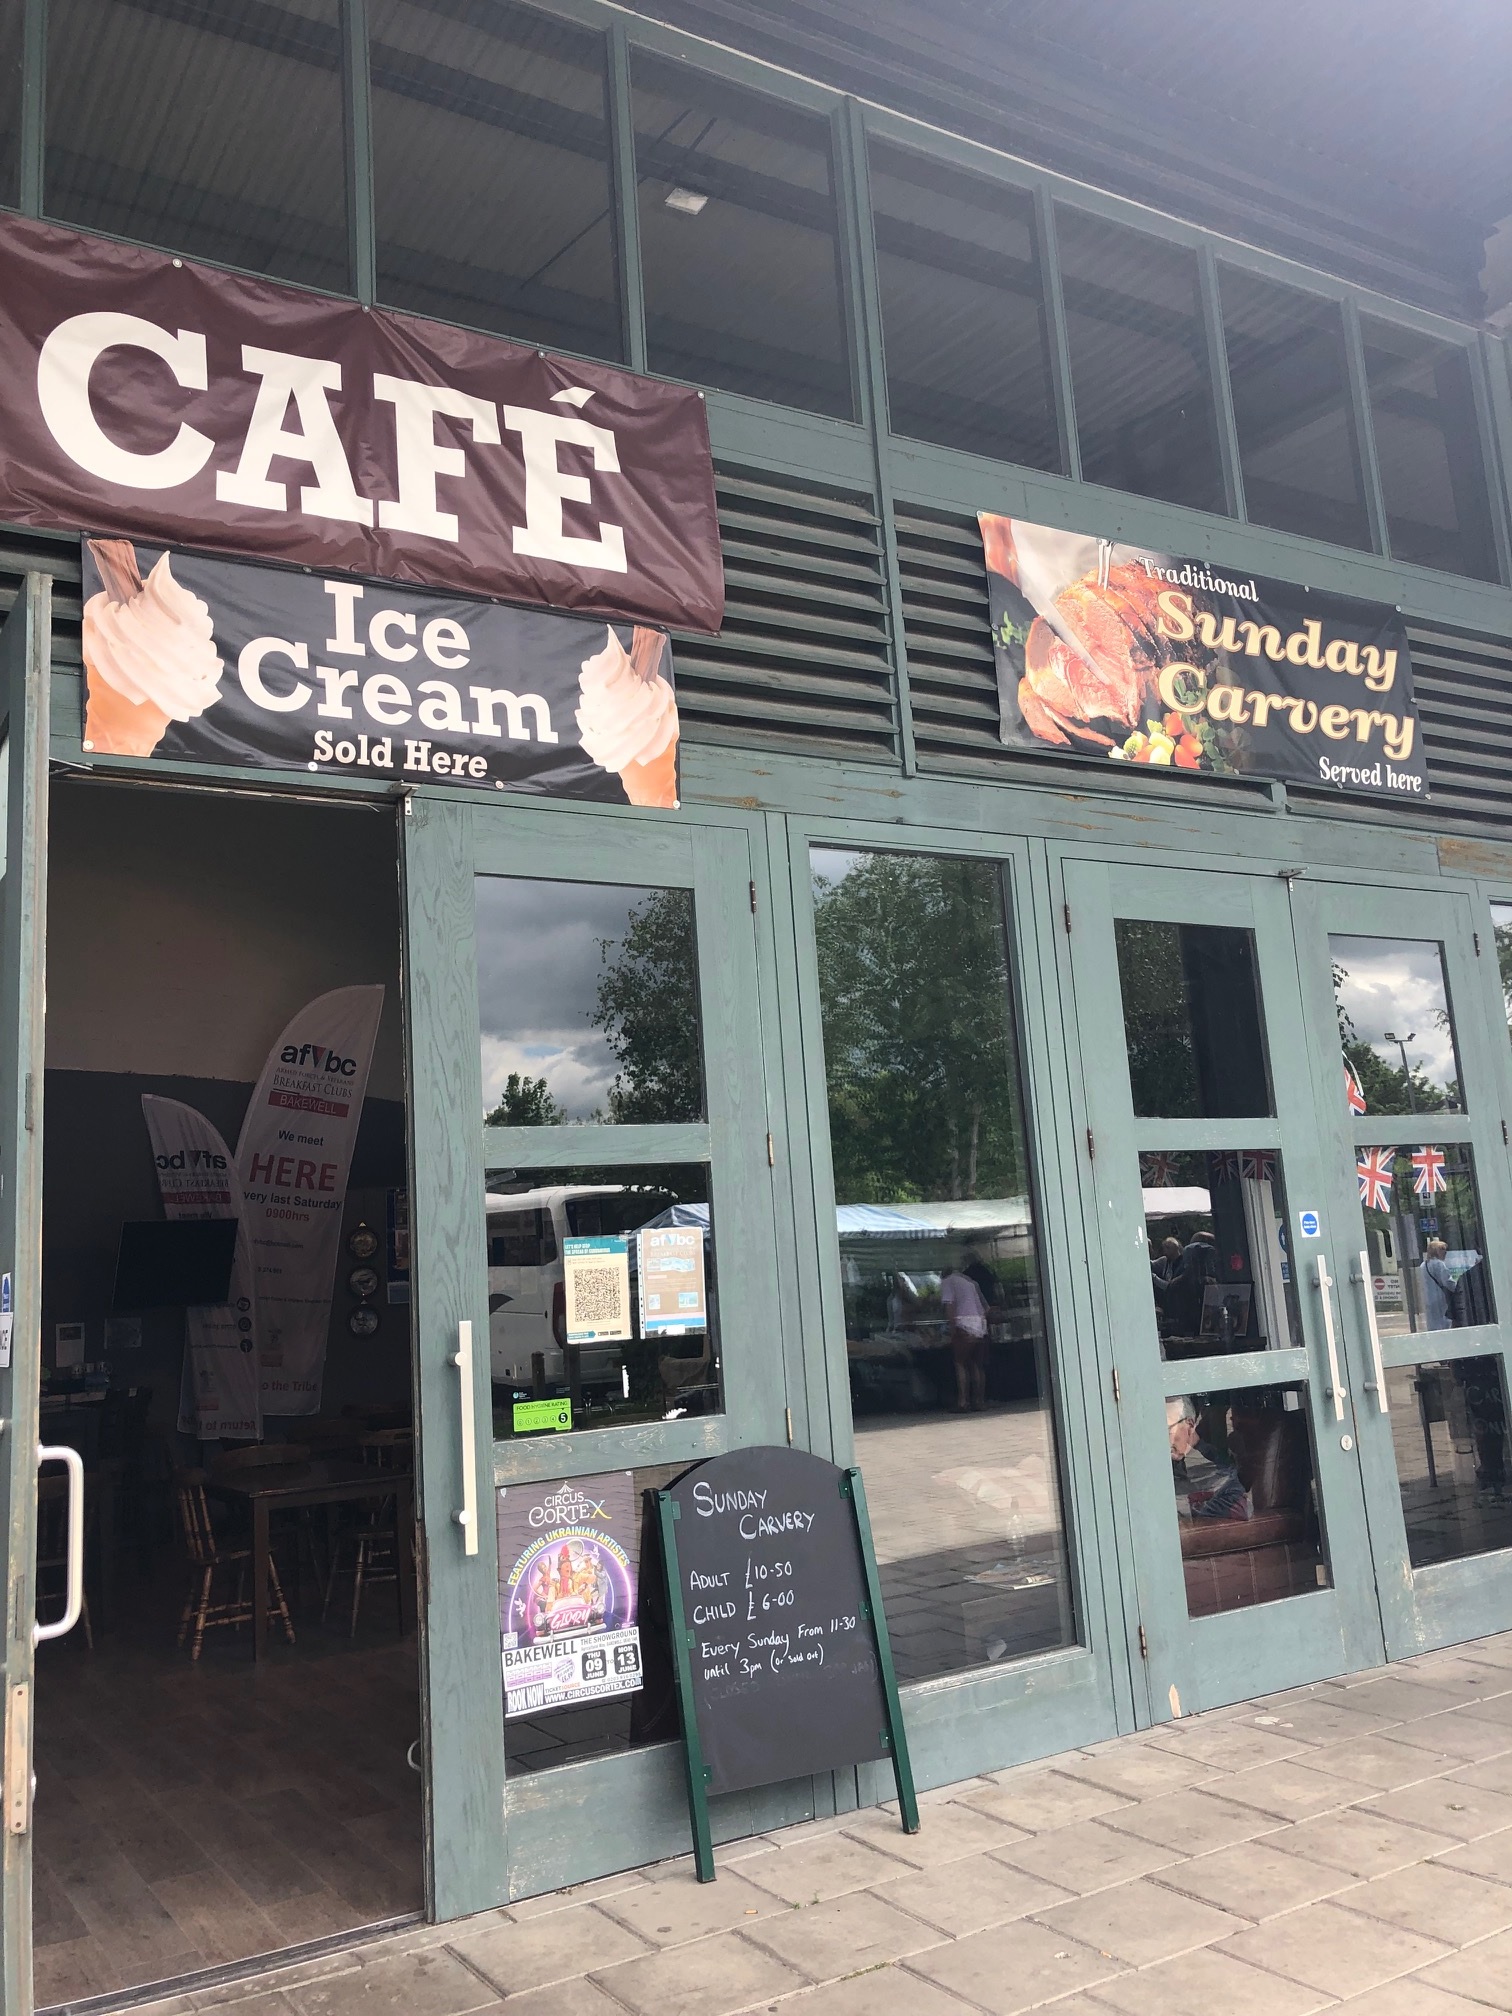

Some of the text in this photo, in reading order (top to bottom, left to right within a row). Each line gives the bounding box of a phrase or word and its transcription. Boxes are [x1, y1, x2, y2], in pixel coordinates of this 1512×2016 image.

[37, 311, 628, 573] CAFÉ
[1138, 556, 1260, 603] Traditional
[324, 580, 471, 669] Ice
[1155, 589, 1398, 692] Sunday
[238, 637, 559, 744] Cream
[1157, 662, 1415, 761] Carvery
[313, 731, 488, 778] Sold Here
[1319, 756, 1422, 793] Served here
[273, 1074, 352, 1099] BREAKFAST CLUBS
[280, 1095, 337, 1115] BAKEWELL
[278, 1130, 324, 1146] We meet
[249, 1153, 337, 1192] HERE
[243, 1191, 342, 1210] very last Saturday
[266, 1208, 310, 1222] 0900hrs
[261, 1381, 318, 1392] o the Tribe
[544, 1491, 584, 1507] CIRCUS
[693, 1481, 767, 1517] SUNDAY
[739, 1511, 815, 1540] CARVERY
[507, 1526, 631, 1586] FEATURING UKRAINIAN ARTISTES
[690, 1571, 730, 1591] ADULT
[550, 1607, 591, 1631] GLORY
[693, 1602, 736, 1625] CHILD
[593, 1629, 637, 1643] SHOWGROUND
[701, 1641, 740, 1659] Every
[748, 1630, 790, 1657] Sunday
[830, 1616, 856, 1632] 11-30
[505, 1639, 578, 1668] BAKEWELL
[587, 1651, 600, 1659] THU
[617, 1653, 635, 1666] 13
[618, 1645, 633, 1653] MON
[585, 1658, 603, 1672] 09
[586, 1671, 604, 1679] JUNE
[618, 1665, 637, 1673] JUNE
[704, 1662, 730, 1681] until
[739, 1658, 763, 1678] 3pm
[508, 1684, 544, 1712] BOOK NOW
